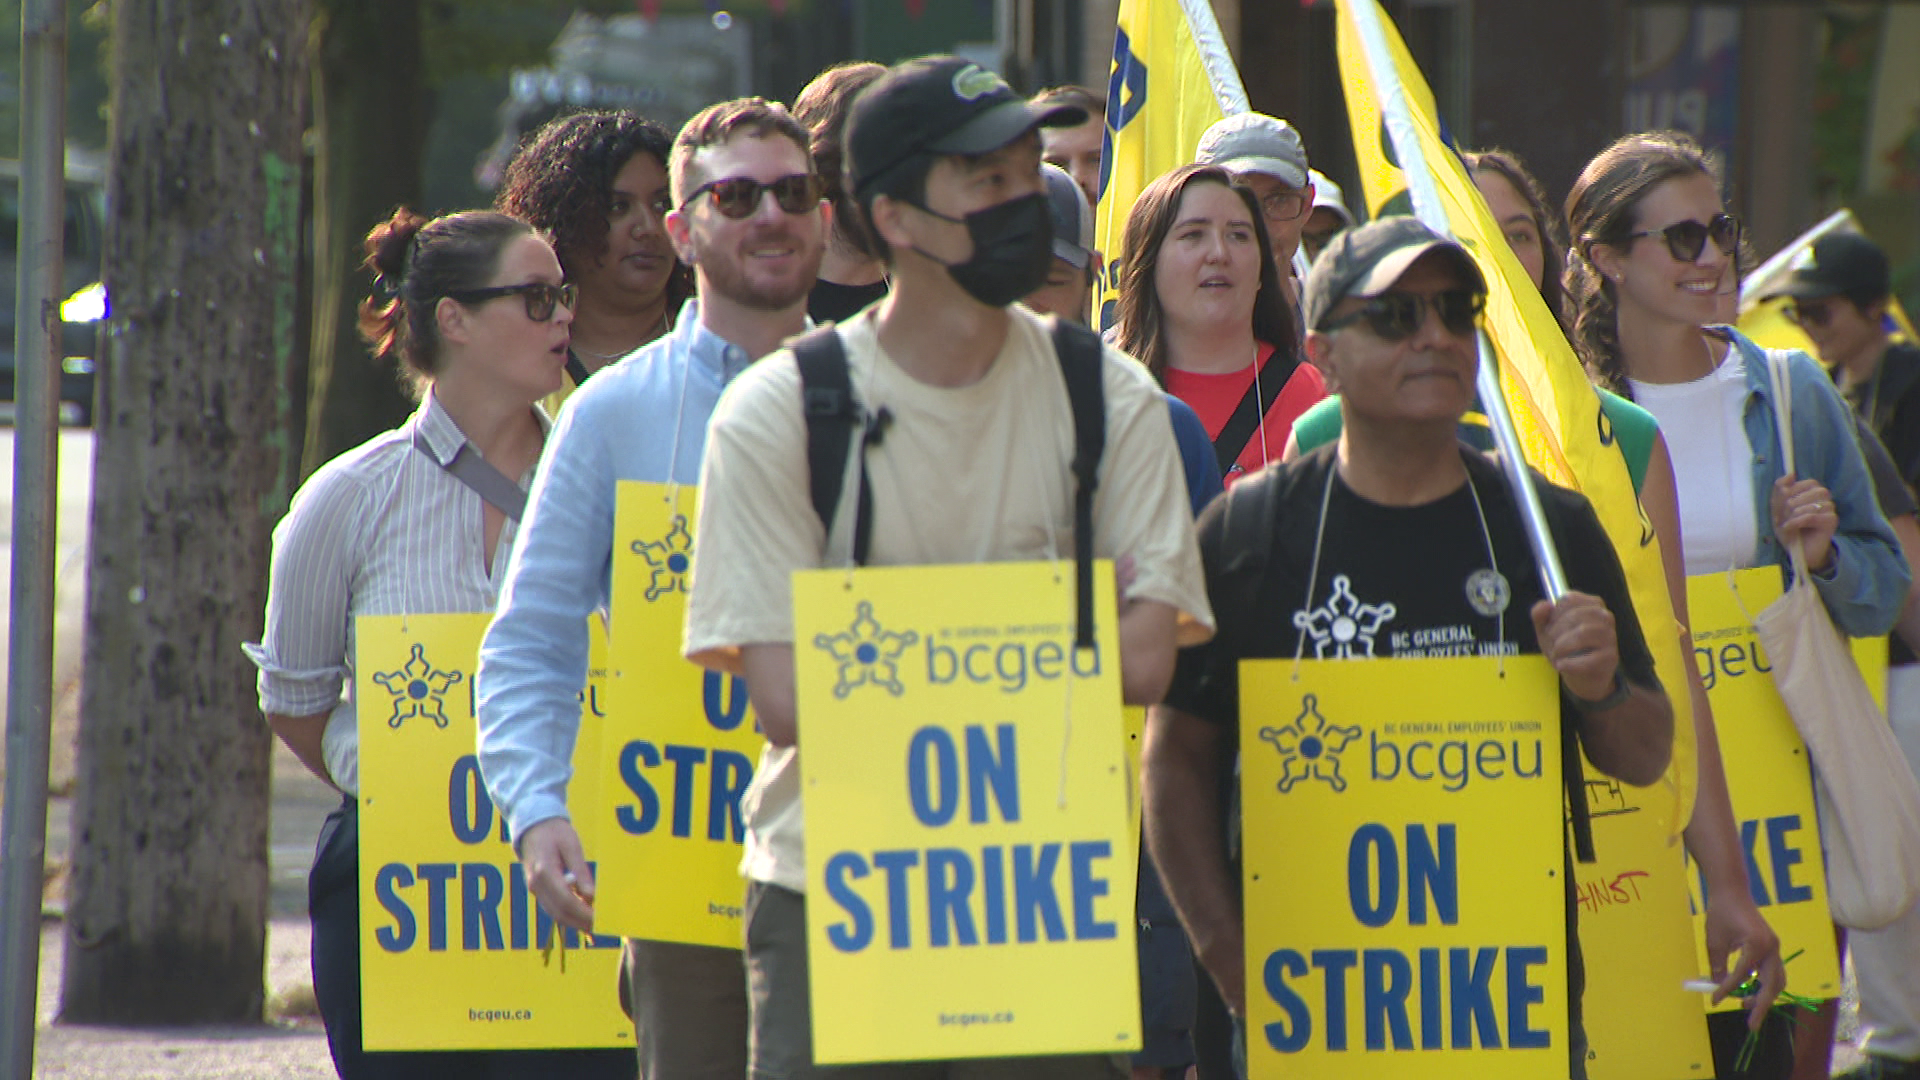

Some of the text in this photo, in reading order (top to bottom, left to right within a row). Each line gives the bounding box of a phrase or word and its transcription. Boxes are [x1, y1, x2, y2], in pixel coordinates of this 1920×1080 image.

[1413, 625, 1475, 646] GENERAL
[1694, 641, 1773, 691] geu
[1370, 728, 1543, 792] bcgeu
[1400, 722, 1443, 735] GENERAL
[1509, 720, 1542, 733] UNION
[449, 754, 511, 844] O
[616, 740, 753, 843] STR
[906, 723, 1022, 829] ON
[375, 862, 621, 953] STRI
[824, 840, 1118, 954] STRIKE
[1348, 823, 1458, 928] ON
[1577, 870, 1650, 914] AINST
[469, 1007, 532, 1022] bcgeu.ca
[1263, 946, 1551, 1054] STRIKE
